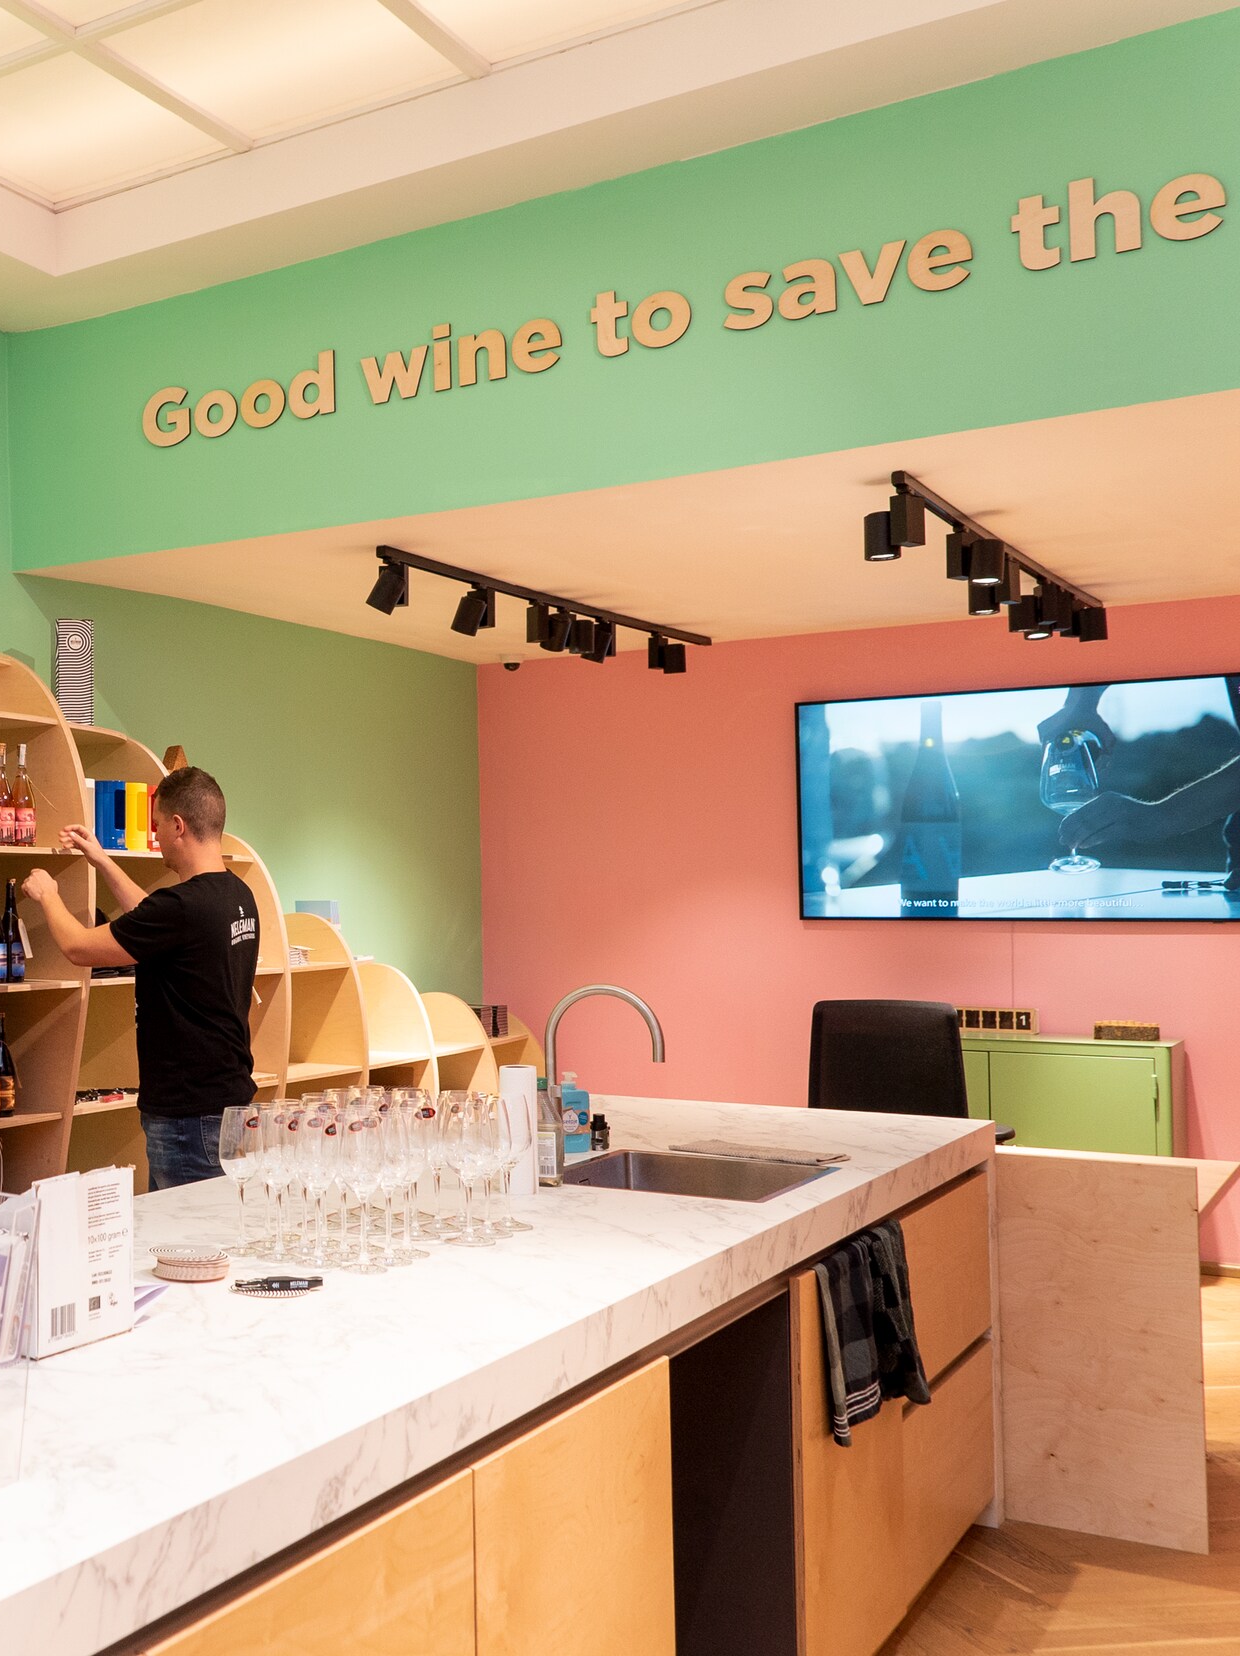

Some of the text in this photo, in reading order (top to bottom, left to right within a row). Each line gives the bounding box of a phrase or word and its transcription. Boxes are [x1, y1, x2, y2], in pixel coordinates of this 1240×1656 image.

[142, 172, 1227, 448] Good wine to save the
[913, 899, 937, 907] want
[938, 899, 949, 907] to
[1019, 1015, 1027, 1026] 1
